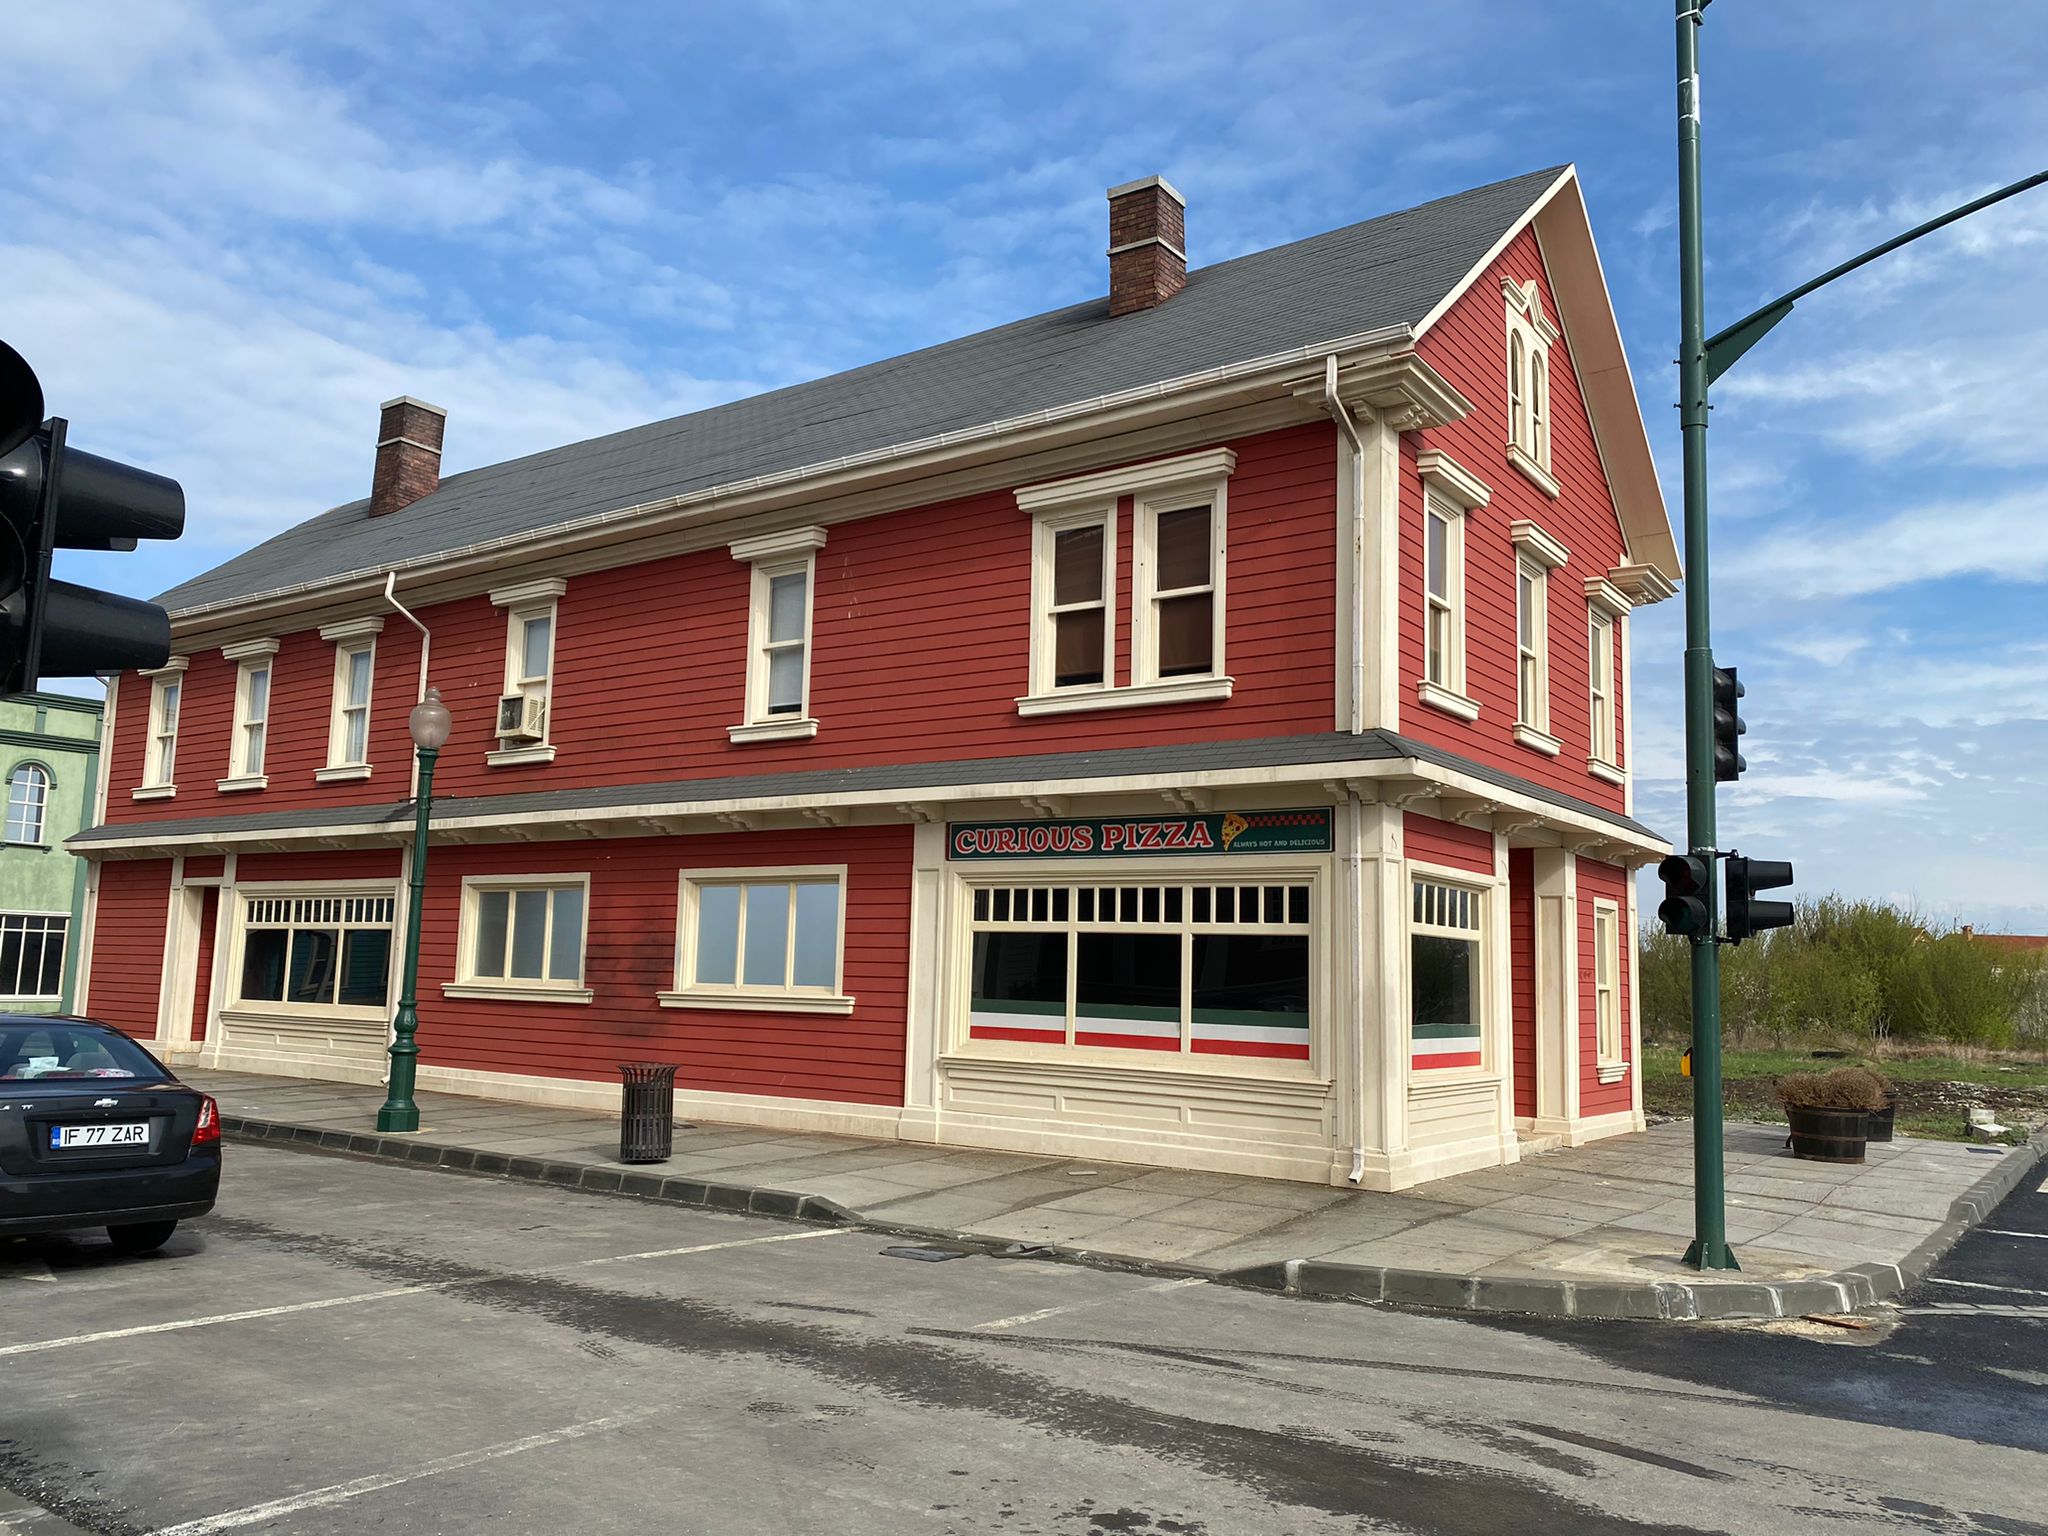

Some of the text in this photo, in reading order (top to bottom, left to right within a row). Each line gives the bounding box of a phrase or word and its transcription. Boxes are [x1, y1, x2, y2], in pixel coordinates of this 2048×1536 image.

[955, 821, 1214, 854] CURIOUS PIZZA
[1233, 840, 1258, 848] ALWAYS
[1274, 839, 1288, 847] AND
[1289, 838, 1326, 846] DELICIOUS
[64, 1128, 80, 1145] IF
[86, 1127, 106, 1143] 77
[111, 1125, 144, 1142] ZAR
